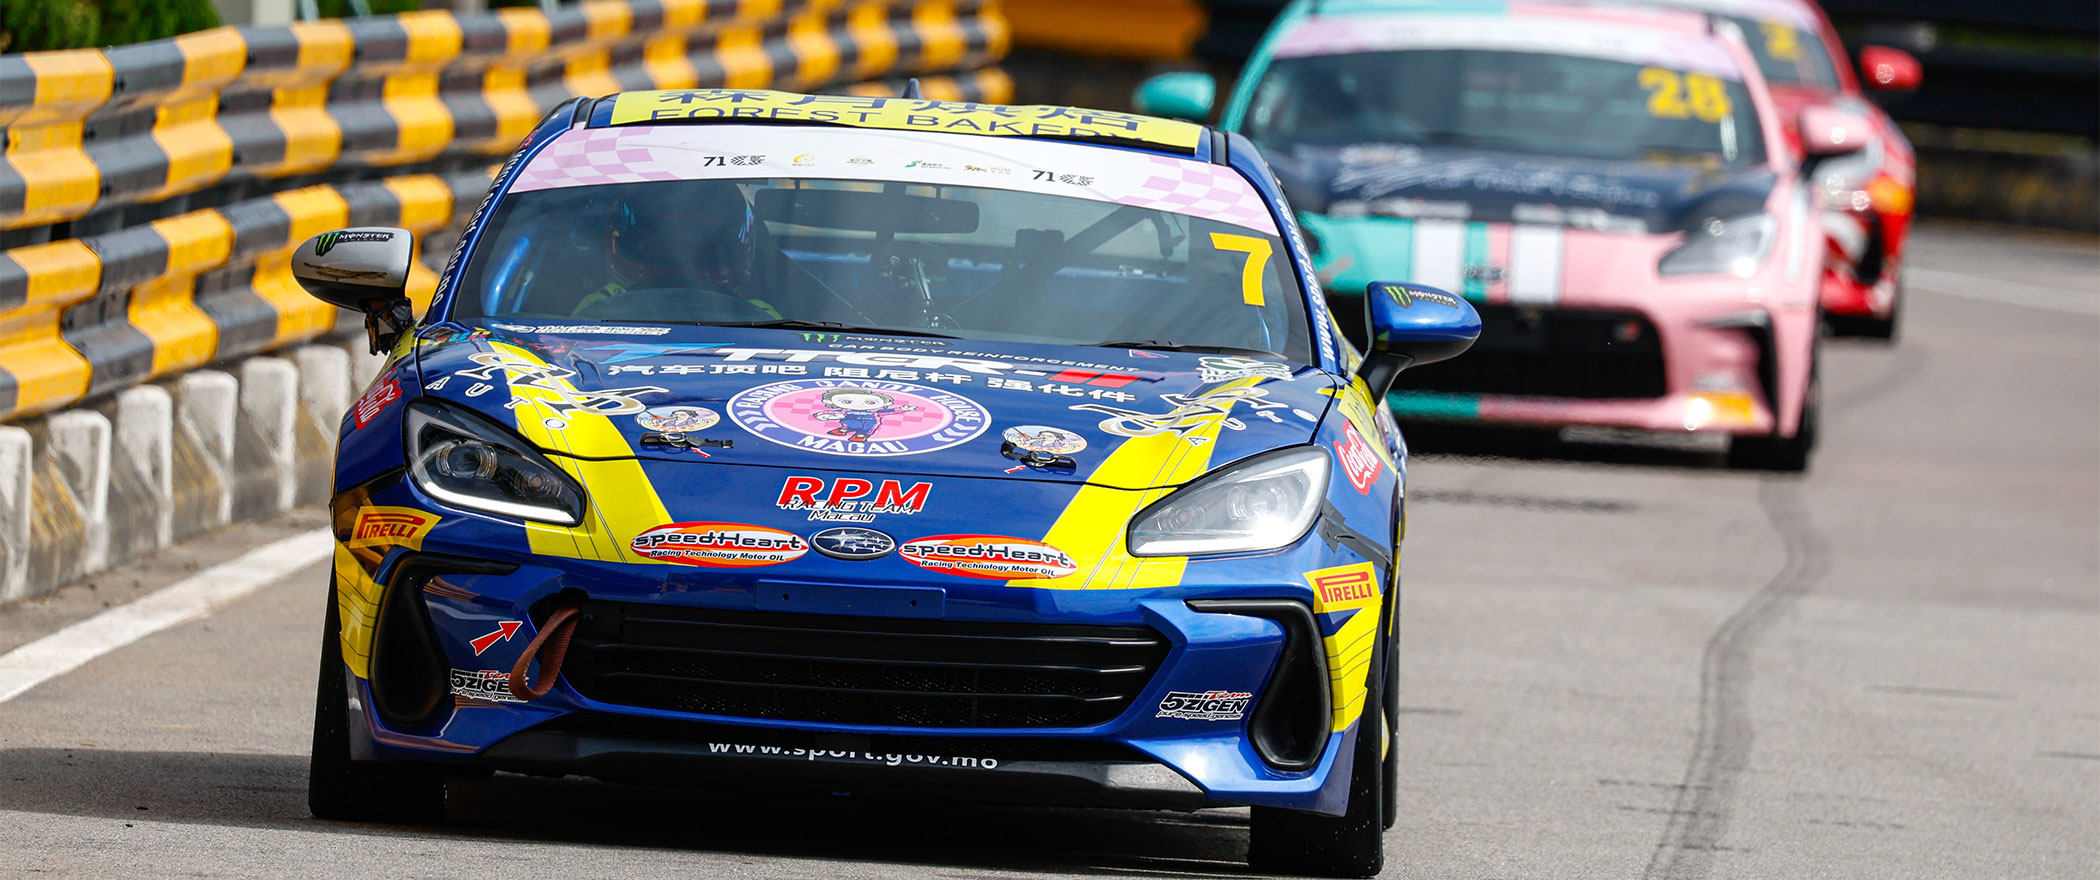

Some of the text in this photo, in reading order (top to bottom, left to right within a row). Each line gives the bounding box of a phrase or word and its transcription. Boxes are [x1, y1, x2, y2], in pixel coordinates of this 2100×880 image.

[1638, 67, 1733, 121] 28
[651, 106, 1144, 141] FOREST BAKER
[703, 156, 727, 167] 71
[1032, 169, 1056, 182] 71
[339, 232, 390, 240] MONSTER
[1209, 232, 1273, 307] 7
[947, 349, 1141, 373] REINFORCEMENT
[823, 366, 973, 386] 阻尼杆
[987, 376, 1137, 404] 强化件
[735, 380, 982, 423] RACING DANDY HOUSE
[796, 435, 909, 454] MACAU
[776, 476, 933, 512] RPM
[782, 499, 918, 514] RACING TEAM
[808, 510, 876, 523] Macau
[356, 513, 427, 540] PIRELLI
[650, 549, 786, 562] Racing Technology Motor OIL
[921, 559, 1056, 577] Racing Technology Motor OIL
[1314, 570, 1373, 604] PIRELLI
[451, 668, 513, 694] 5ZIGE
[480, 670, 512, 680] Tea
